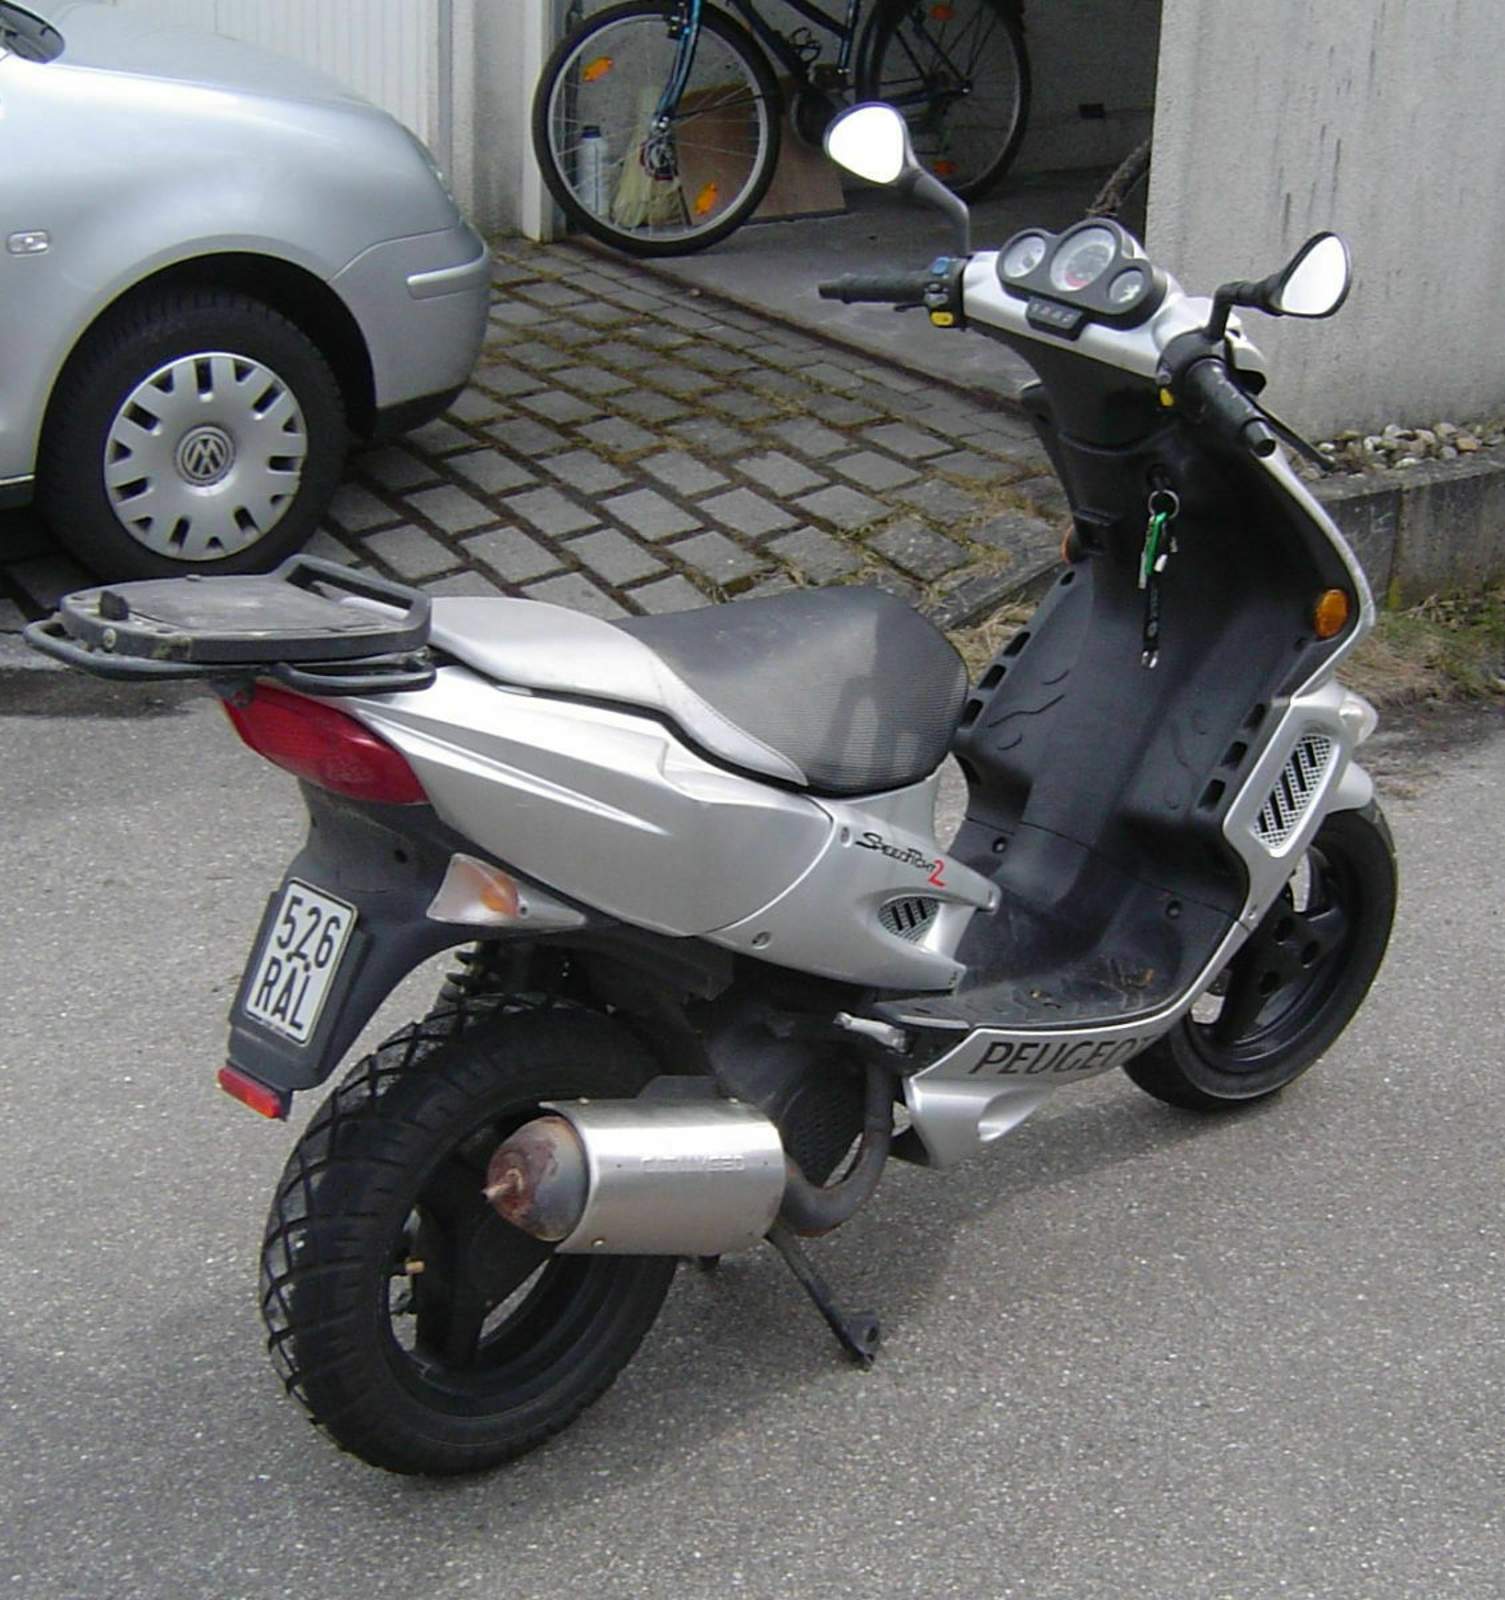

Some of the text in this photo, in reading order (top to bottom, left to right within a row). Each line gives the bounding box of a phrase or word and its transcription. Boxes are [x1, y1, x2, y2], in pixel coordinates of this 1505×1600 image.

[928, 859, 945, 888] 2
[277, 896, 341, 969] 526
[254, 956, 311, 1031] RAL
